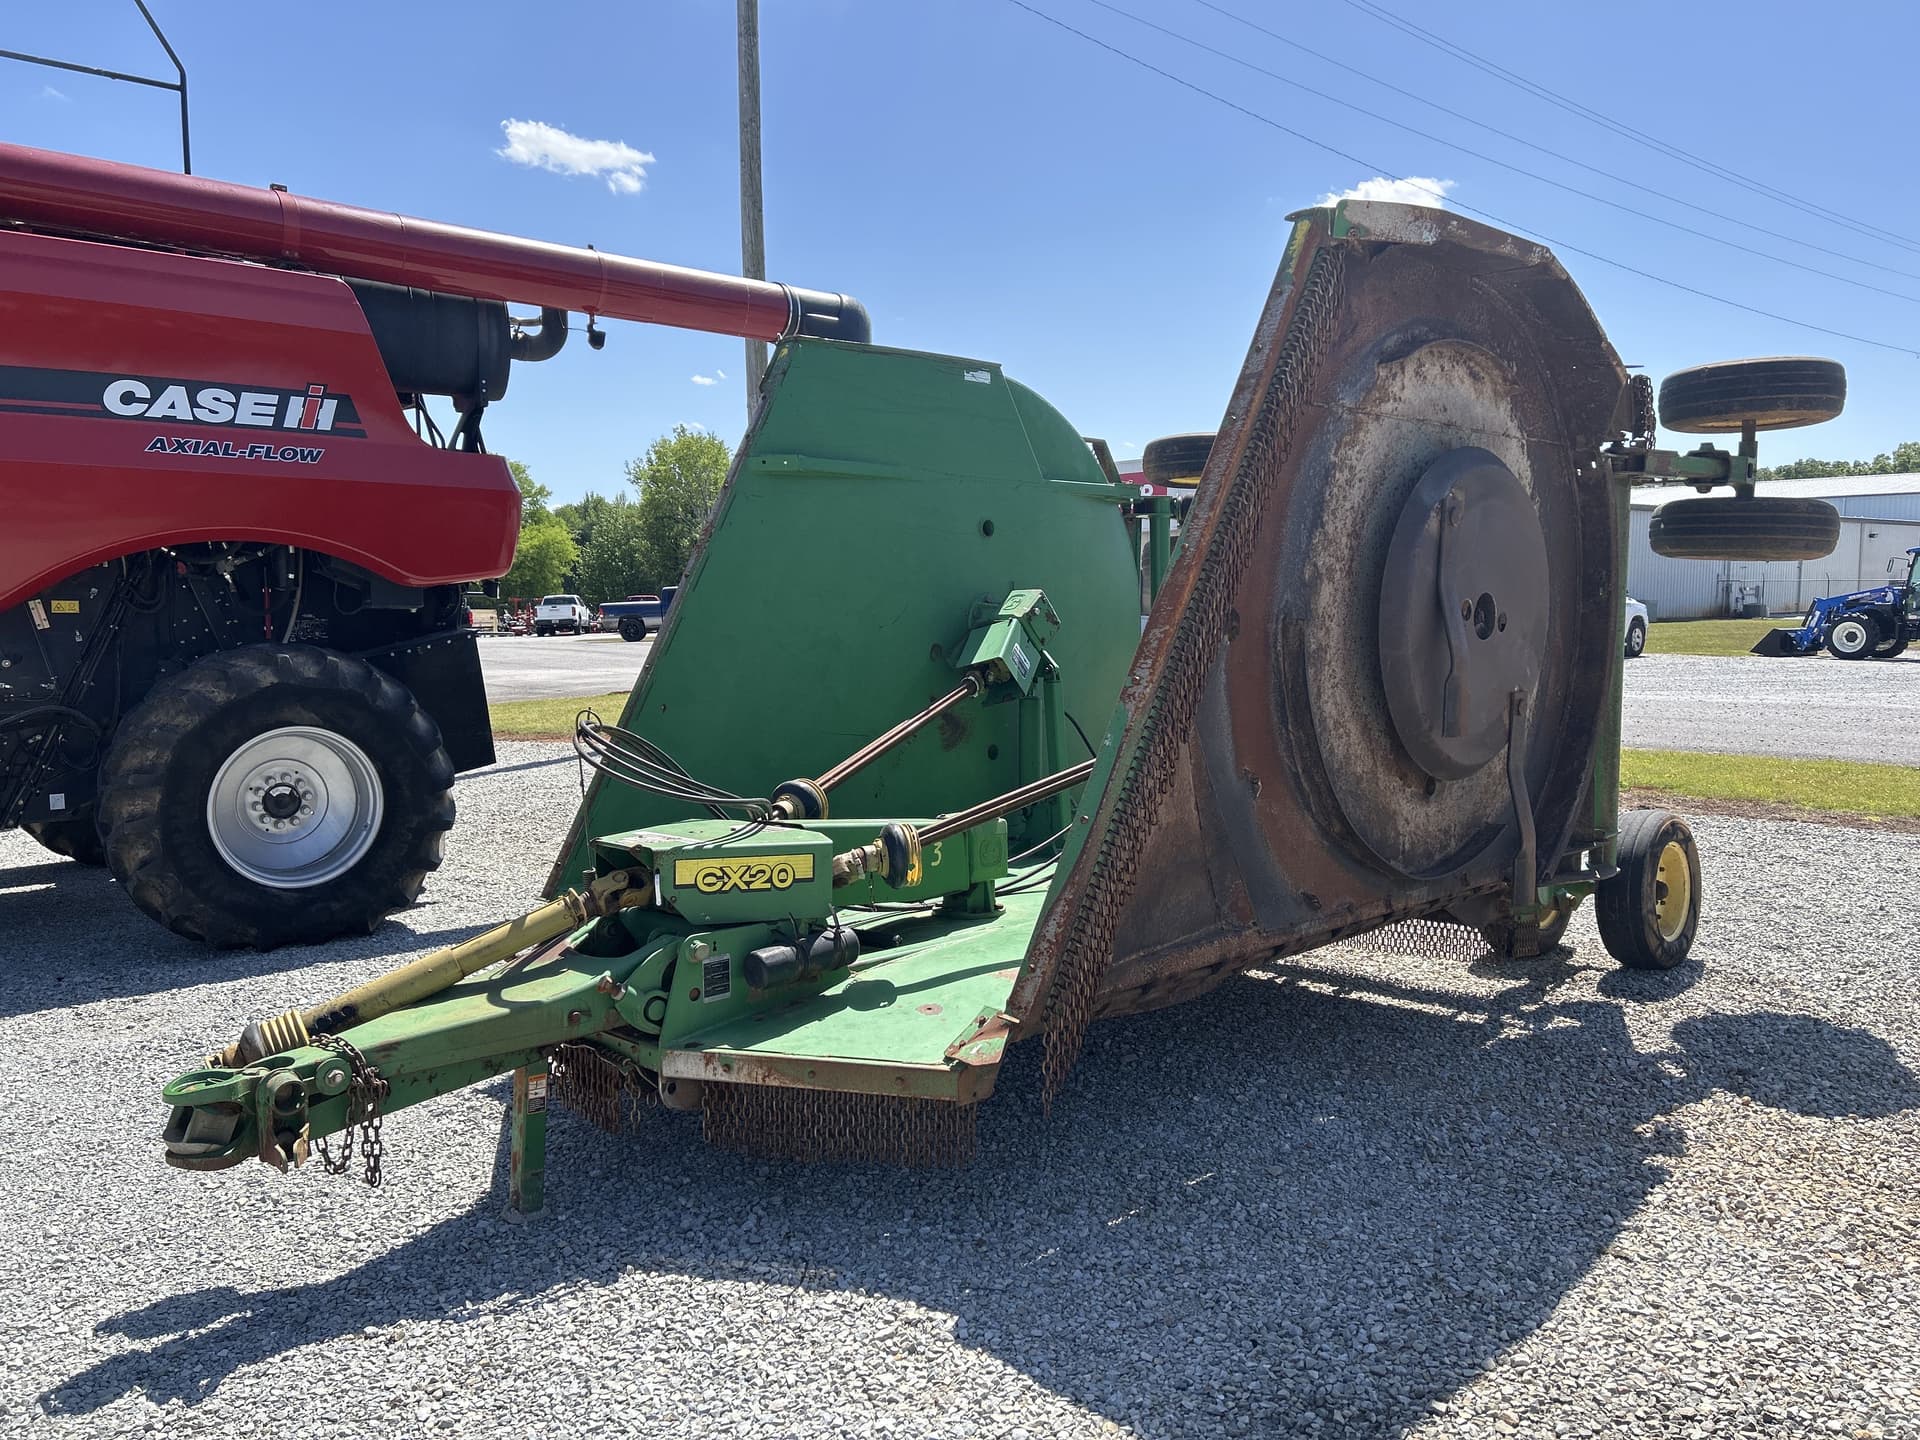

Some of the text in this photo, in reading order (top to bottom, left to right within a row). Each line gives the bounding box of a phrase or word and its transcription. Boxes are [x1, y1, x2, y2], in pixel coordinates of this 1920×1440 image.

[103, 380, 279, 426] CASE
[144, 436, 325, 464] AXIAL-FLOW
[931, 841, 942, 867] 3
[695, 862, 795, 893] CX20
